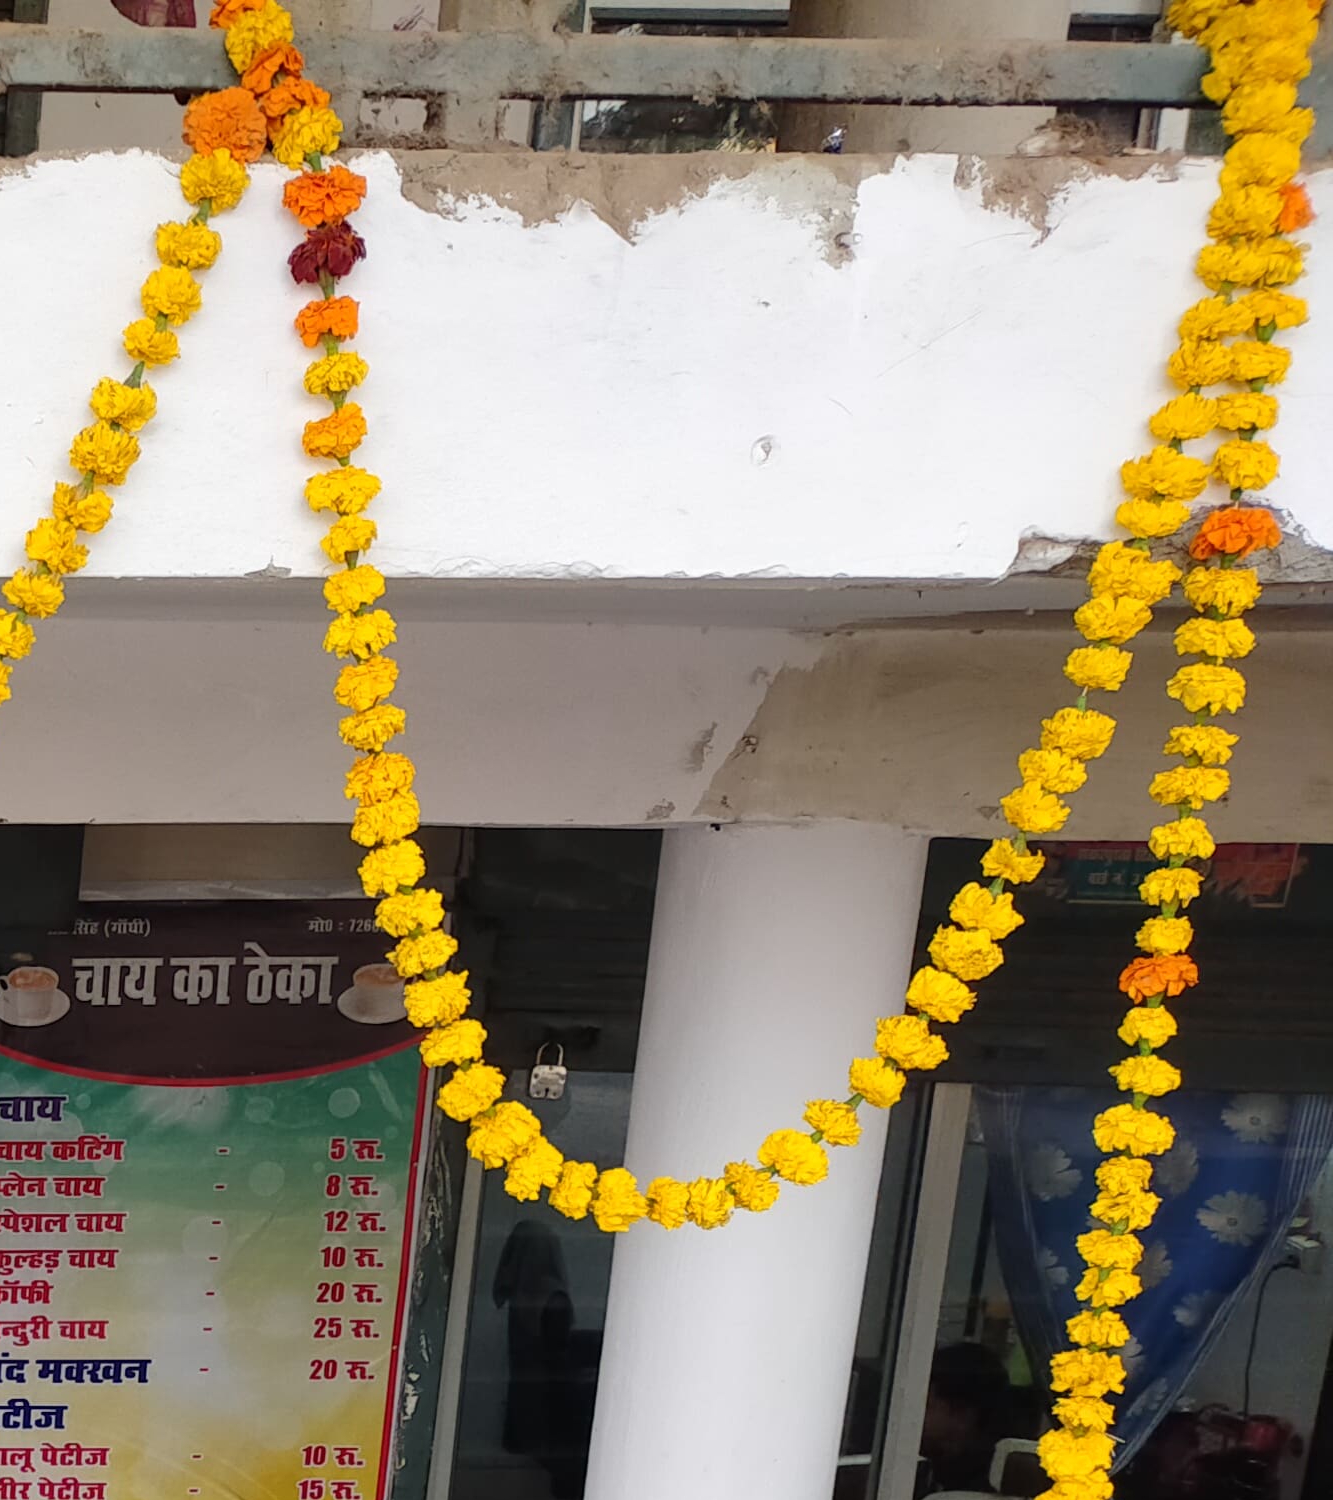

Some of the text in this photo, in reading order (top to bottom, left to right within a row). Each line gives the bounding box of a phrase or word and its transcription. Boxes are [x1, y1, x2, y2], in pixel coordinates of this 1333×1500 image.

[71, 942, 339, 1005] चाय का ठेका
[0, 1096, 65, 1122] चाय
[52, 1135, 124, 1161] कटिंग
[330, 1139, 346, 1161] 5
[53, 1176, 105, 1198] चाय
[326, 1175, 342, 1197] 8
[75, 1212, 124, 1233] चाय
[325, 1212, 349, 1233] 12
[68, 1248, 118, 1270] चाय
[323, 1247, 347, 1269] 10
[317, 1281, 346, 1304] 20
[59, 1319, 108, 1341] चाय
[314, 1316, 343, 1340] 25
[36, 1359, 152, 1384] मक्खन
[309, 1359, 339, 1382] 20
[40, 1442, 111, 1468] पेटीज
[303, 1444, 328, 1467] 10
